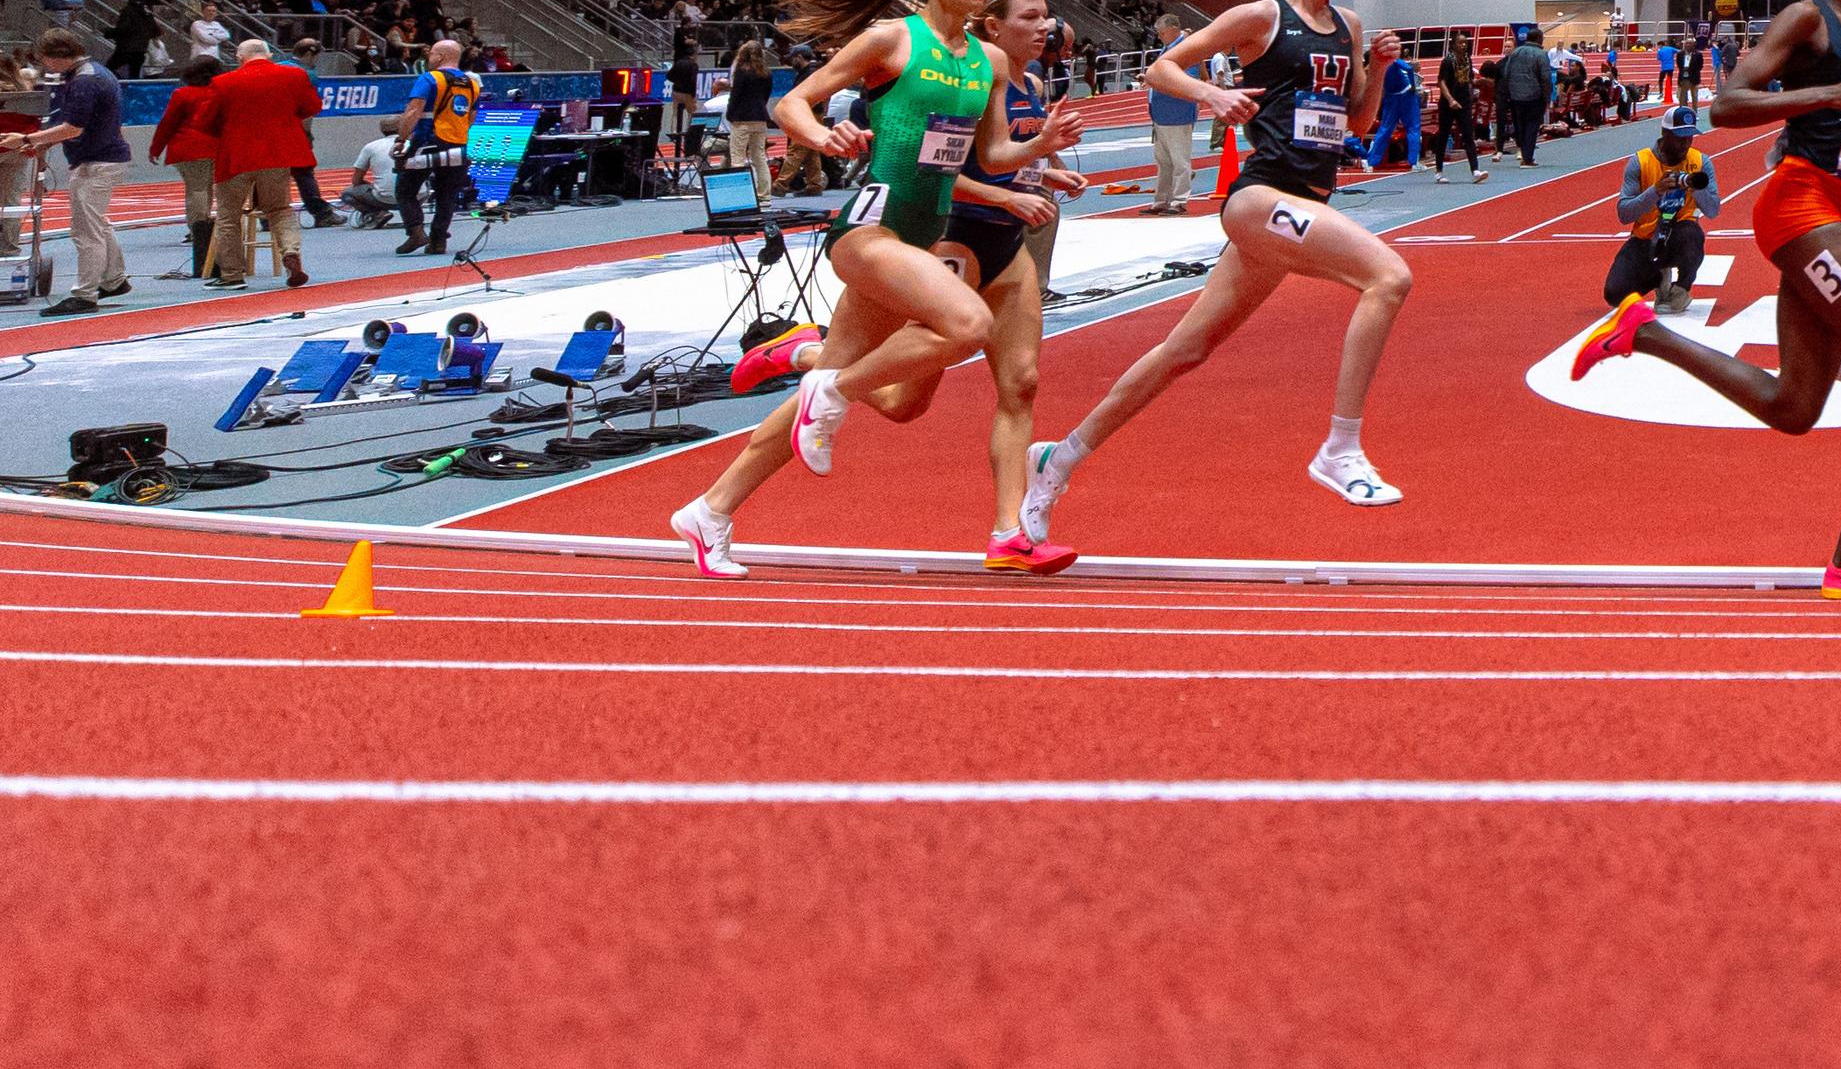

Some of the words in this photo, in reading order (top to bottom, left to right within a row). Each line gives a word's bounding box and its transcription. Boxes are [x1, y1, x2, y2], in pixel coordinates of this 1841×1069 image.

[1310, 54, 1350, 96] H
[335, 85, 379, 109] FIELD
[856, 186, 882, 221] 7
[1272, 210, 1310, 237] 2
